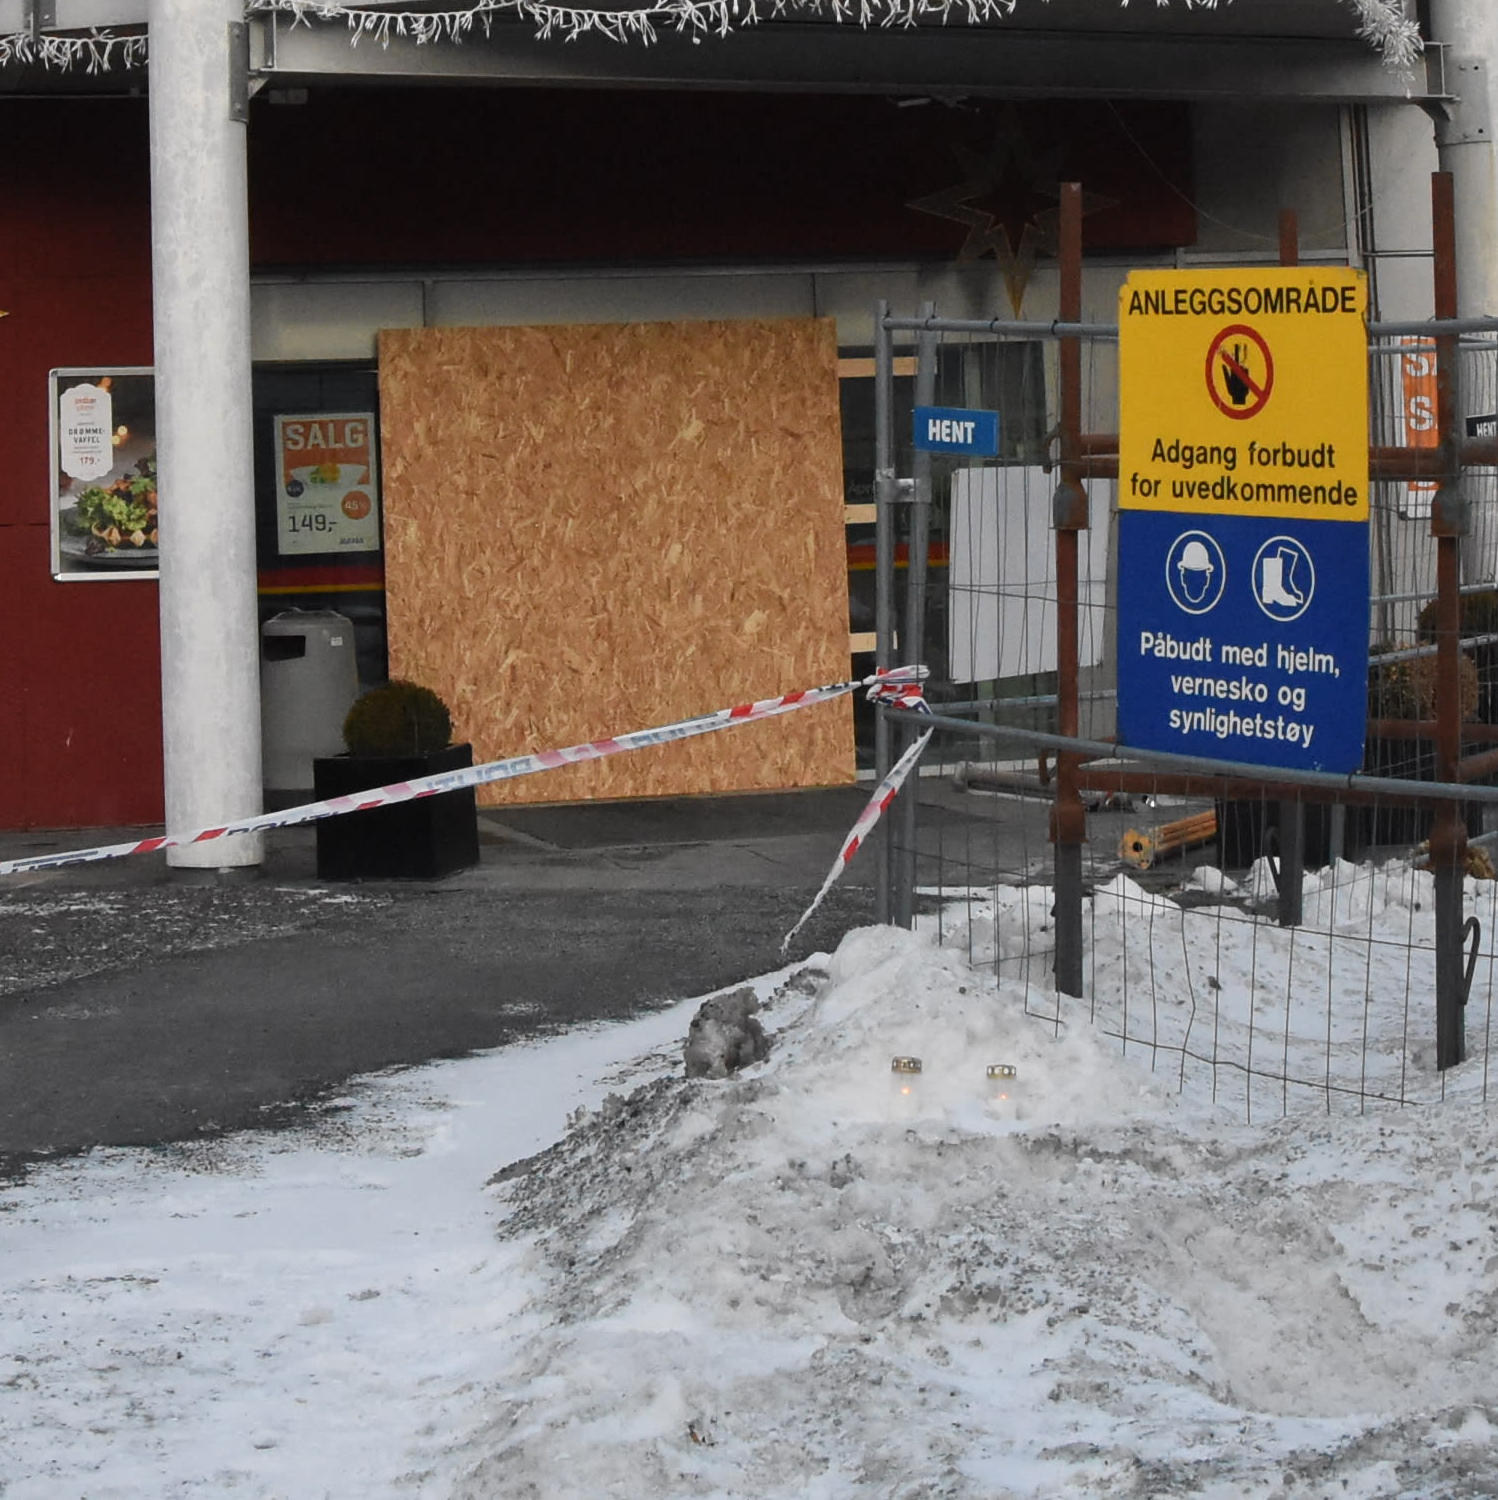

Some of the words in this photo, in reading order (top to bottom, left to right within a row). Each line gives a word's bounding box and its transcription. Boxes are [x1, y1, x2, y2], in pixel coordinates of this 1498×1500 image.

[1128, 284, 1357, 316] ANLEGGSOMRÅDE
[285, 421, 364, 451] SALG
[927, 418, 976, 444] HENT
[1151, 438, 1237, 471] Adgang
[1248, 441, 1336, 469] forbudt
[1130, 472, 1162, 498] for
[1171, 476, 1358, 507] uvedkommende
[287, 514, 338, 533] 149,-
[1140, 632, 1212, 662] Påbudt
[1221, 643, 1268, 668] med
[1277, 644, 1341, 679] hjelm,
[1171, 674, 1269, 703] vernesko
[1277, 685, 1306, 712] og
[1168, 706, 1314, 748] synlighetstøy
